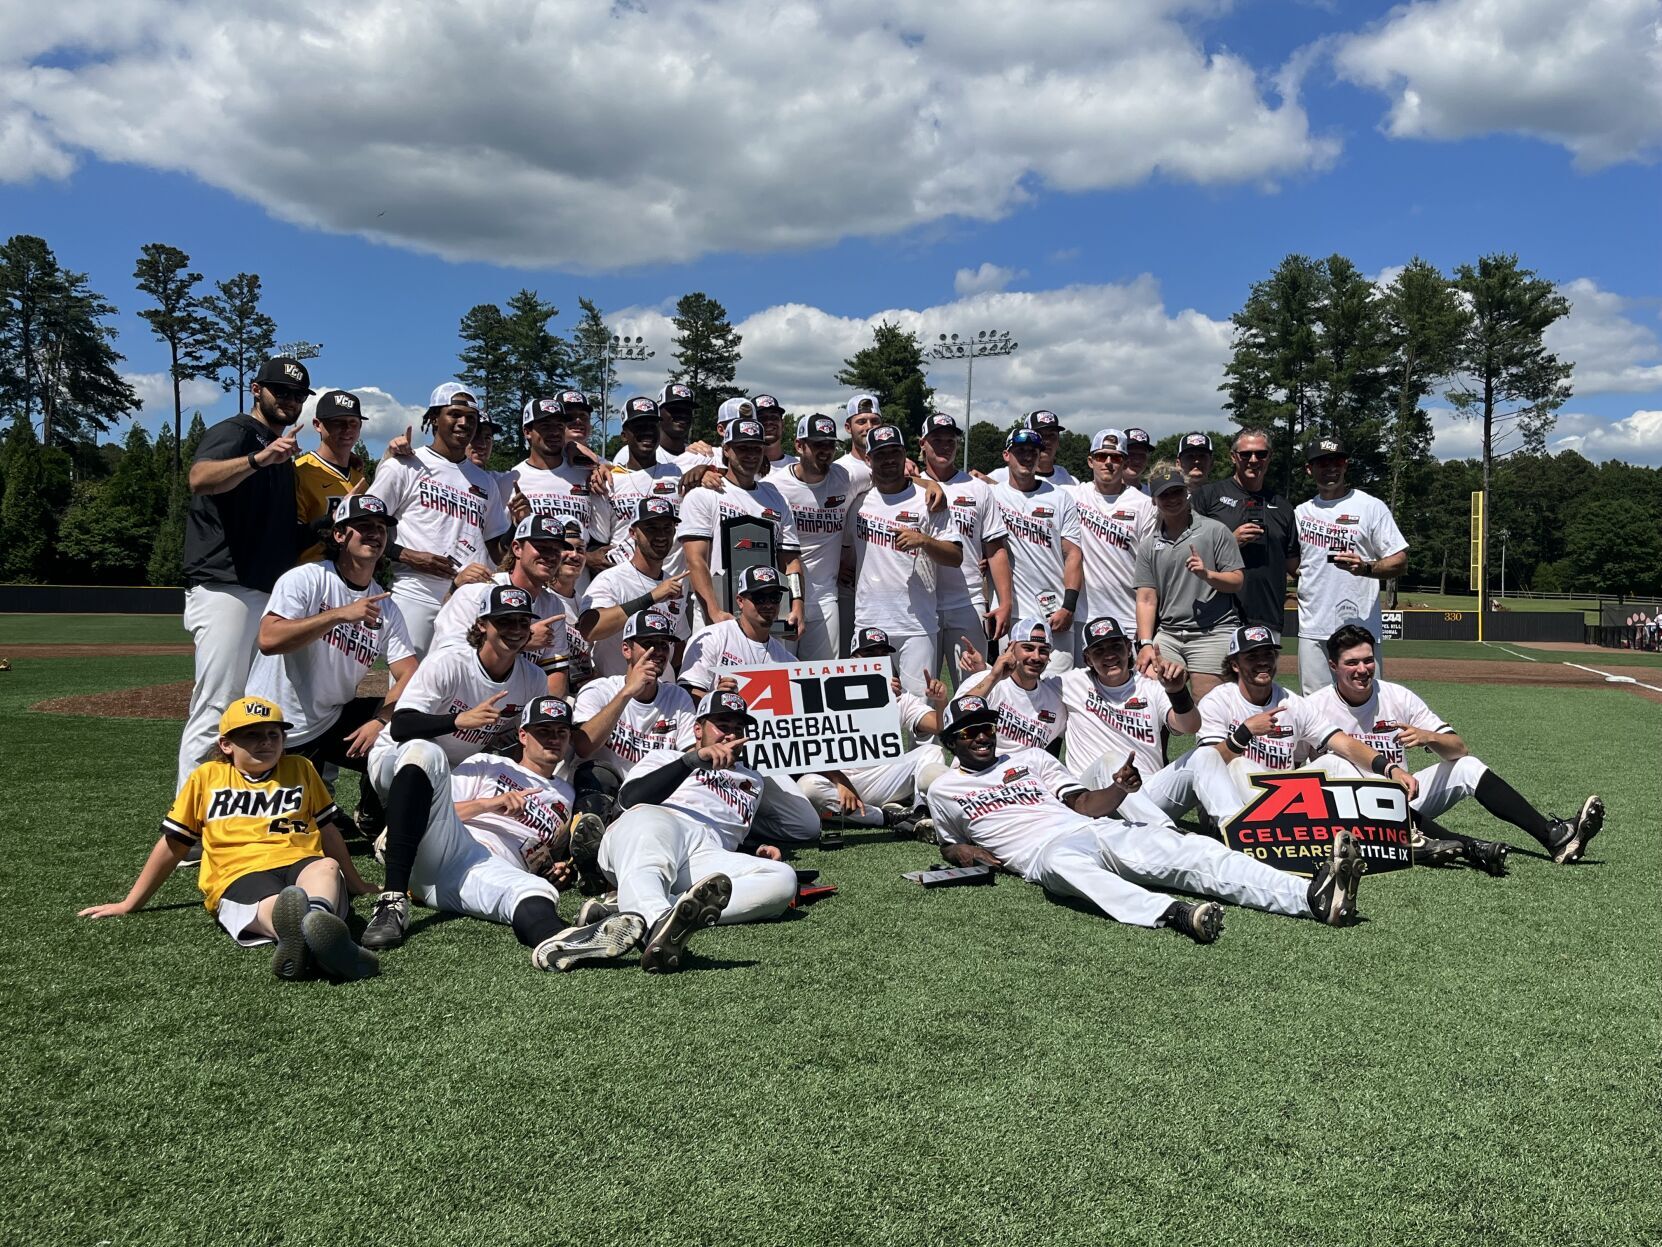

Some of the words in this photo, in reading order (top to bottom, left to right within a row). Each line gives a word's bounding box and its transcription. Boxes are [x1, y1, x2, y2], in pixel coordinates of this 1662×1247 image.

[284, 363, 303, 381] VCU
[334, 395, 355, 409] VCU
[1320, 440, 1338, 451] VCU
[531, 499, 592, 514] ASEBALL
[1381, 613, 1402, 622] CAA
[1444, 612, 1462, 622] 330
[245, 702, 272, 717] VCU
[745, 713, 860, 741] BASEBALL
[737, 733, 901, 771] HAMPIONS
[208, 786, 303, 820] RAMS
[1242, 777, 1407, 822] A10
[1243, 847, 1268, 859] 50
[1271, 844, 1332, 859] YEARS
[1359, 844, 1397, 860] TITLE
[1398, 848, 1409, 861] IX
